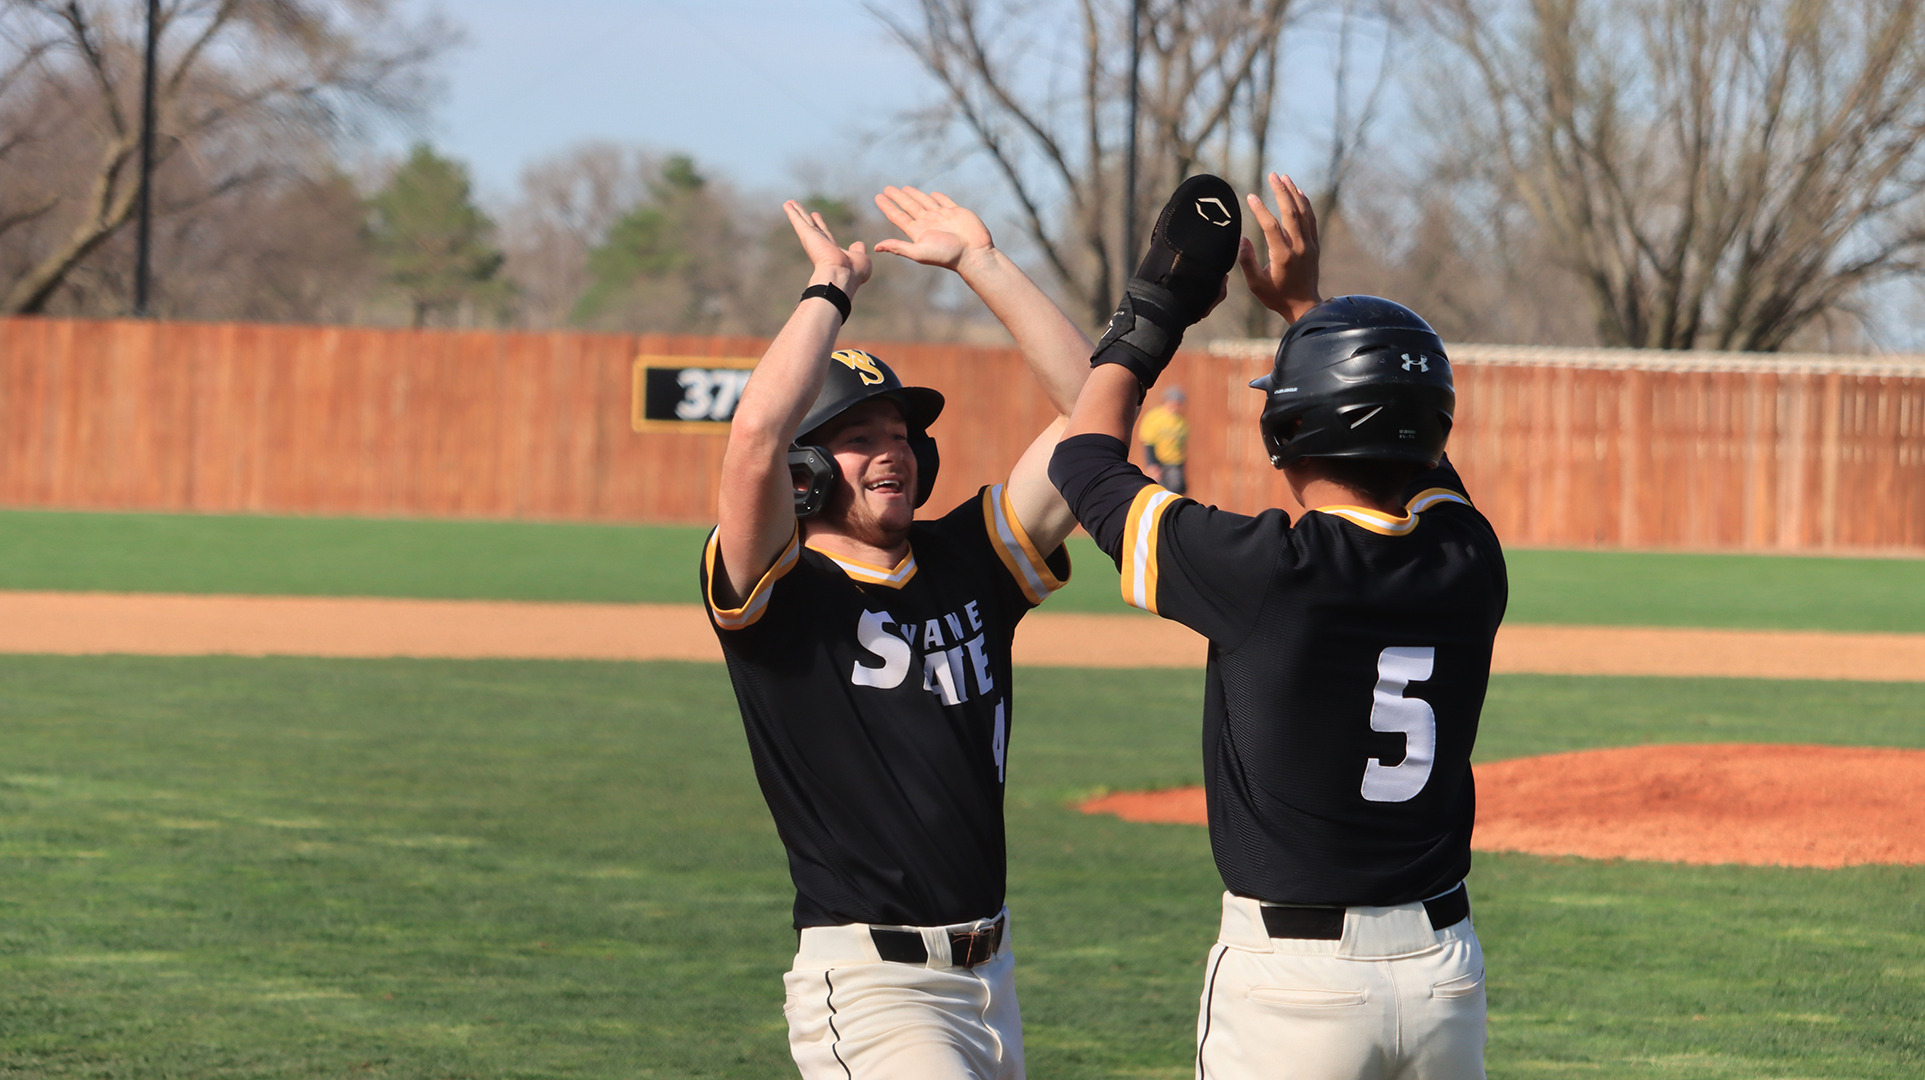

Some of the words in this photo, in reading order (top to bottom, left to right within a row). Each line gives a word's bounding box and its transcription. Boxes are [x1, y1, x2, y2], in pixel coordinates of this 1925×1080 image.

[675, 367, 754, 421] 37
[851, 608, 994, 706] SATE
[1360, 646, 1436, 802] 5
